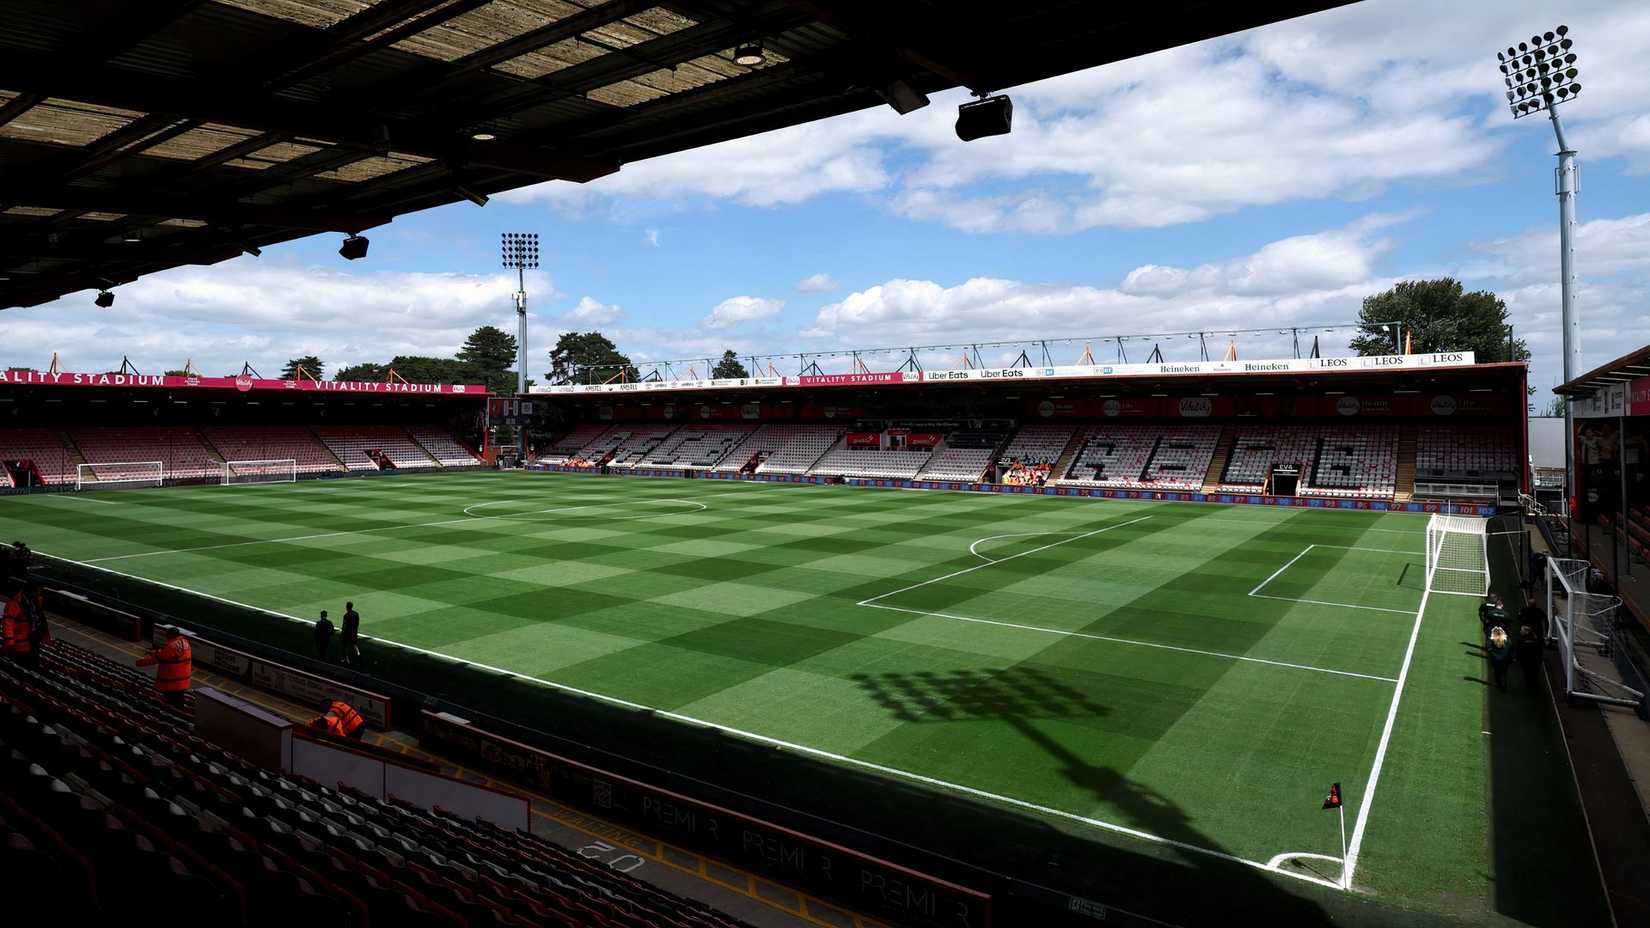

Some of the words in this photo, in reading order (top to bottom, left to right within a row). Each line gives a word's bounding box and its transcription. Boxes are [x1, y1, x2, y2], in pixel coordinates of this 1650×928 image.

[1375, 357, 1403, 366] LEOS
[1433, 353, 1463, 363] LEOS
[1245, 362, 1289, 371] Heineken
[1321, 359, 1348, 367] LEOS
[981, 369, 1001, 378] Uber
[1002, 369, 1024, 377] Eats
[1160, 365, 1200, 373] Heineken
[74, 373, 165, 386] STADIUM
[806, 376, 846, 384] VITALITY
[851, 374, 892, 383] STADIUM
[928, 371, 947, 380] Uber
[949, 371, 969, 379] Eats
[315, 380, 381, 390] VITALITY
[385, 383, 442, 393] STADIUM
